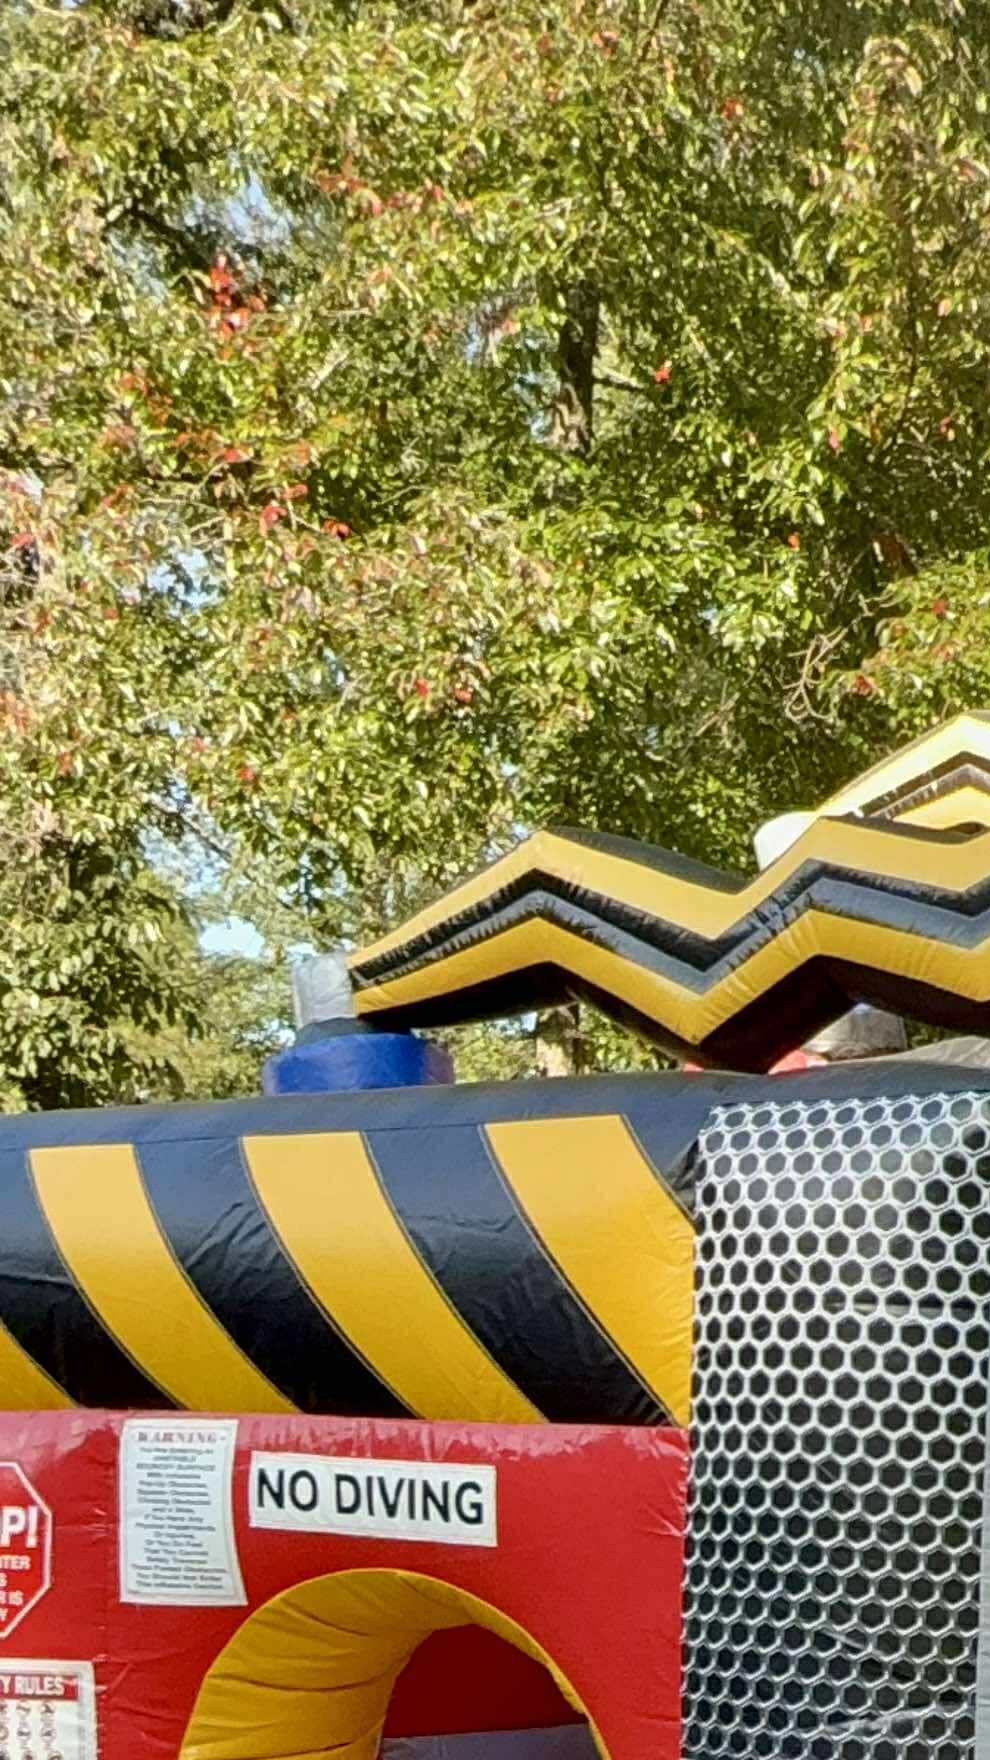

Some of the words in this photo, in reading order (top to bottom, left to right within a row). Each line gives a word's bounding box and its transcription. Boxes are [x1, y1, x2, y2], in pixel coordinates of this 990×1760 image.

[257, 1467, 319, 1512] NO
[334, 1472, 484, 1526] DIVING
[14, 1675, 66, 1697] RULES
